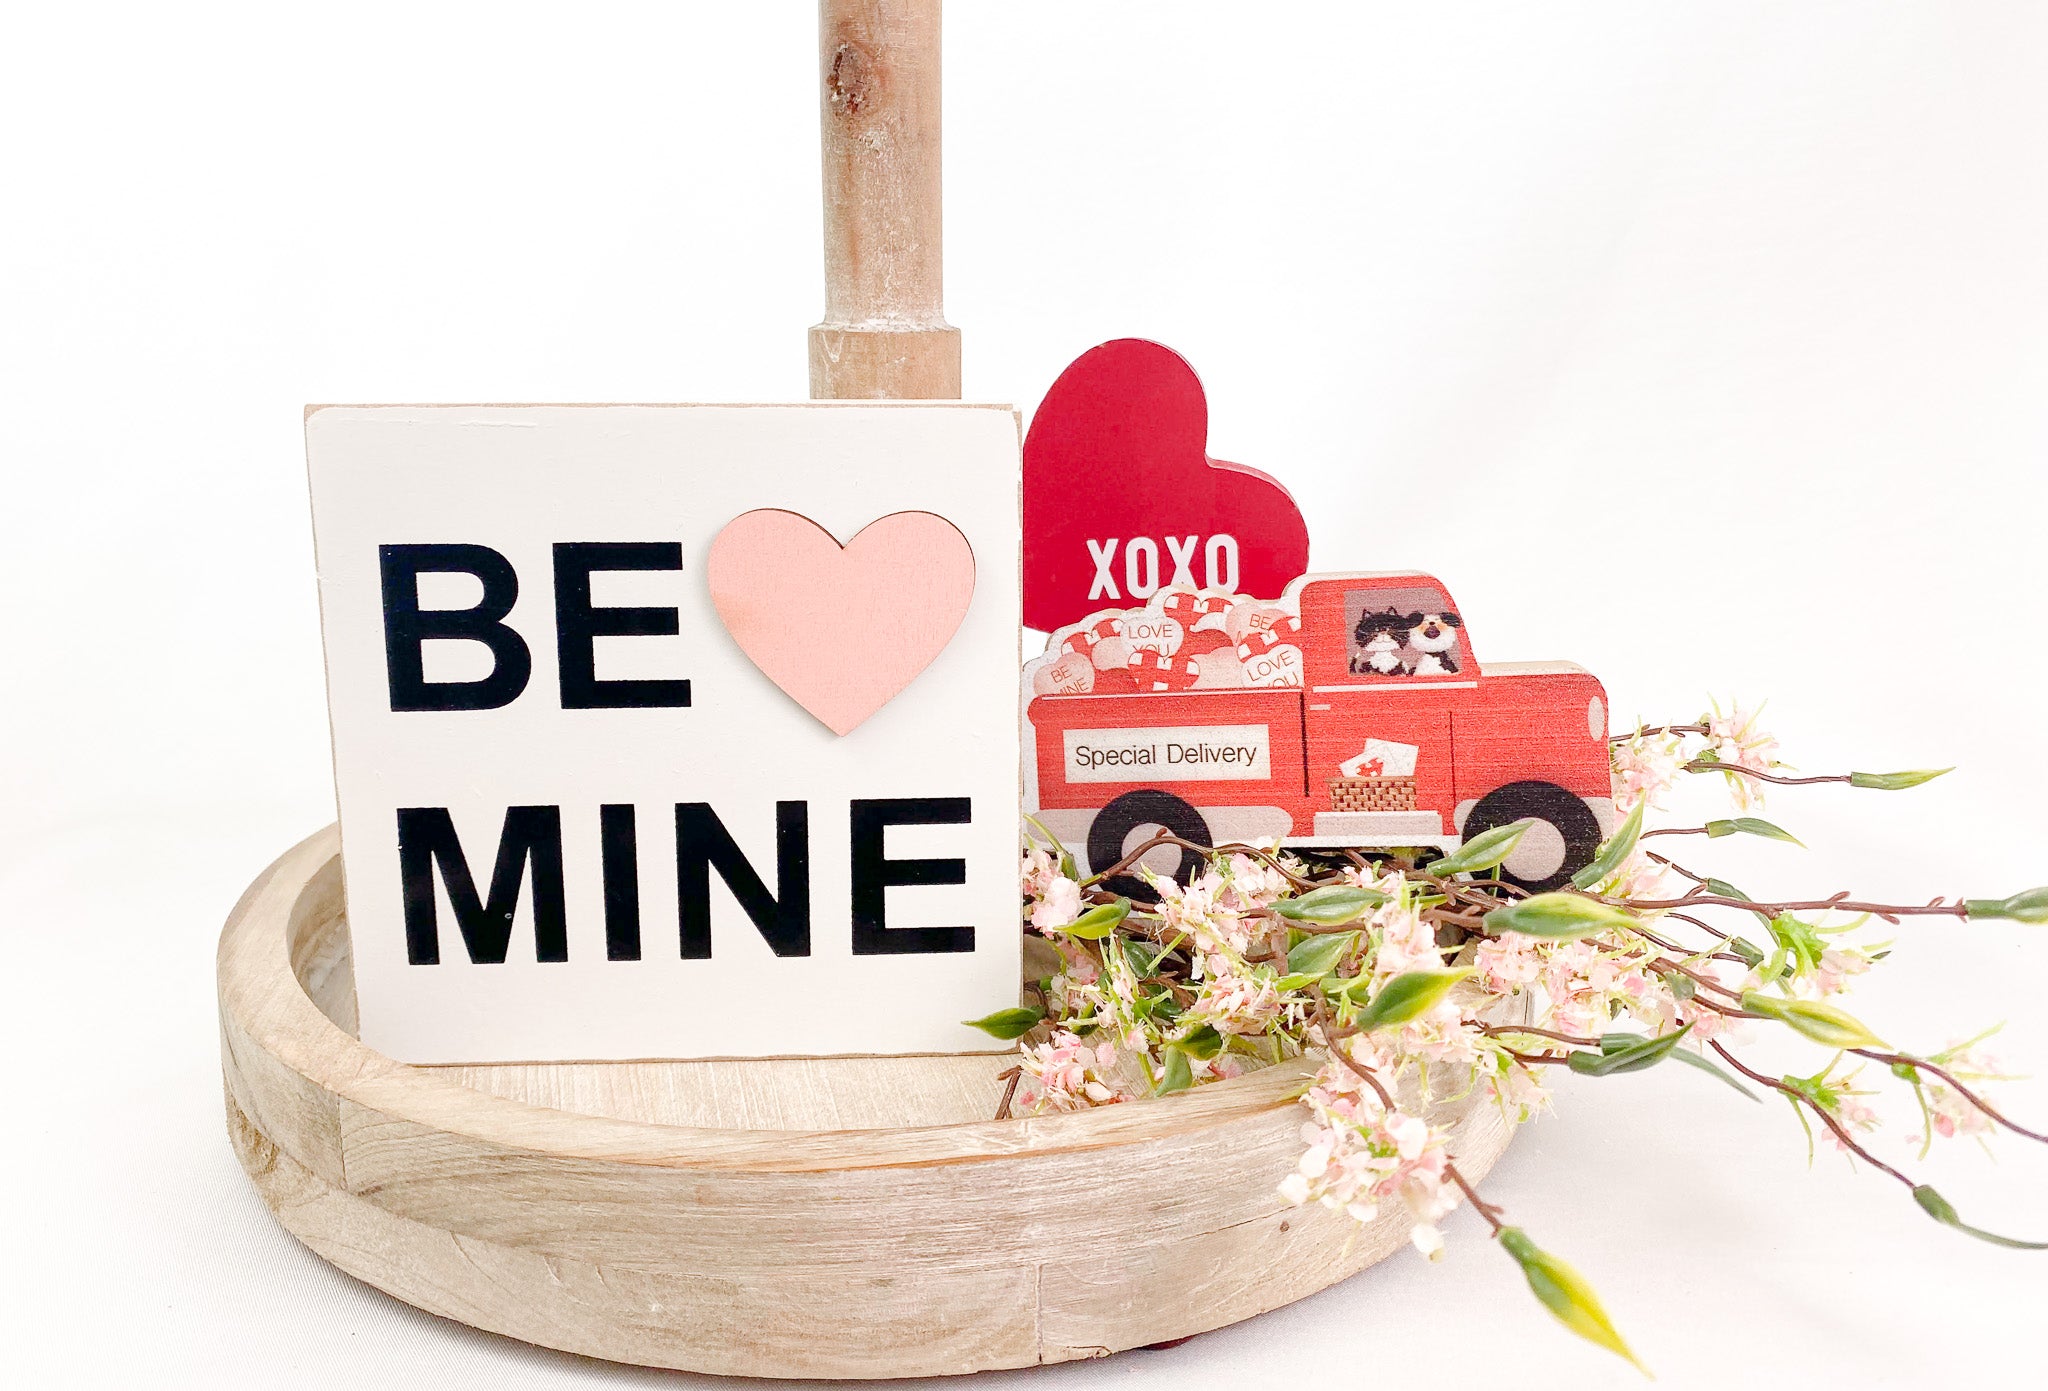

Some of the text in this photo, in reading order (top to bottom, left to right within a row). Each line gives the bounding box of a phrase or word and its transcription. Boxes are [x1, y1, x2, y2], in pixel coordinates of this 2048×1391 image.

[1086, 534, 1240, 600] XOXO
[378, 541, 692, 712] BE
[1128, 623, 1173, 639] LOVE
[1249, 613, 1272, 630] BE
[1050, 664, 1073, 683] BE
[1246, 650, 1295, 682] LOVE
[1075, 743, 1257, 770] Special Delivery
[396, 796, 976, 965] MINE
